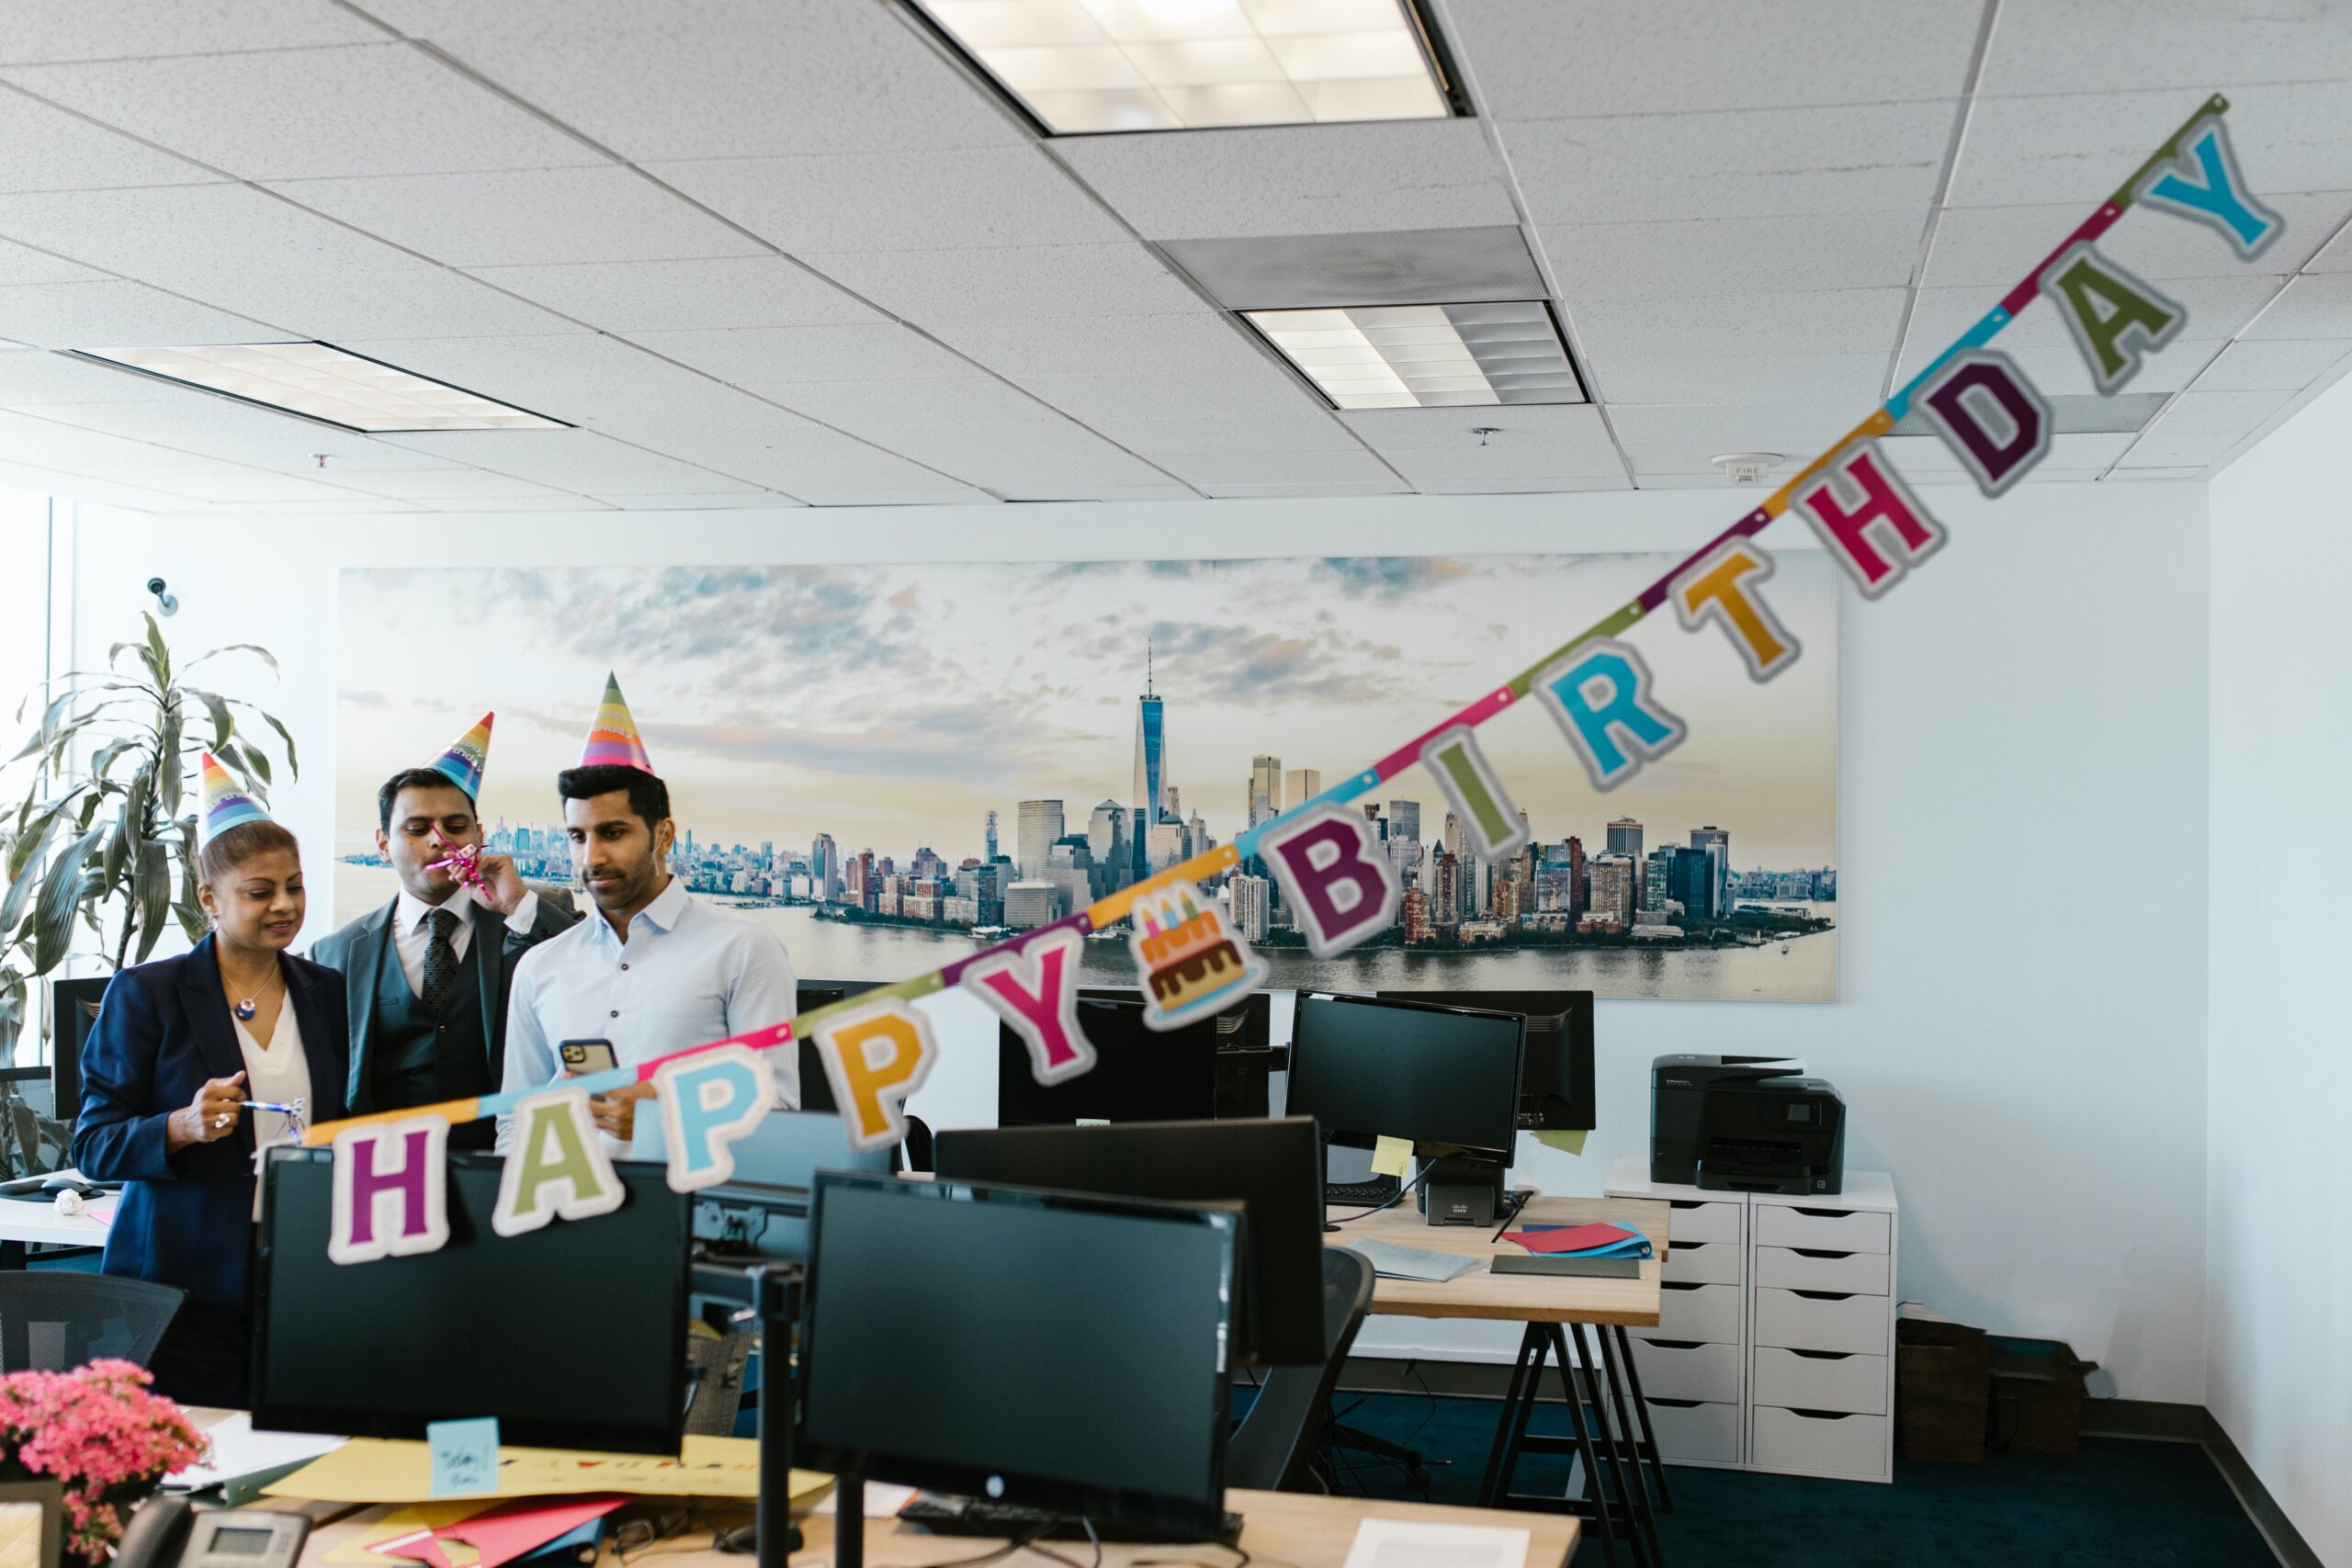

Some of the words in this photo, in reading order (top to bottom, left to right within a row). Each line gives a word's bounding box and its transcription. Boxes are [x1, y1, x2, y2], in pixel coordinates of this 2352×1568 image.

[334, 935, 1093, 1257] HAPPY
[1266, 121, 2277, 952] BIRTHDAY
[1736, 467, 1760, 475] FIRE
